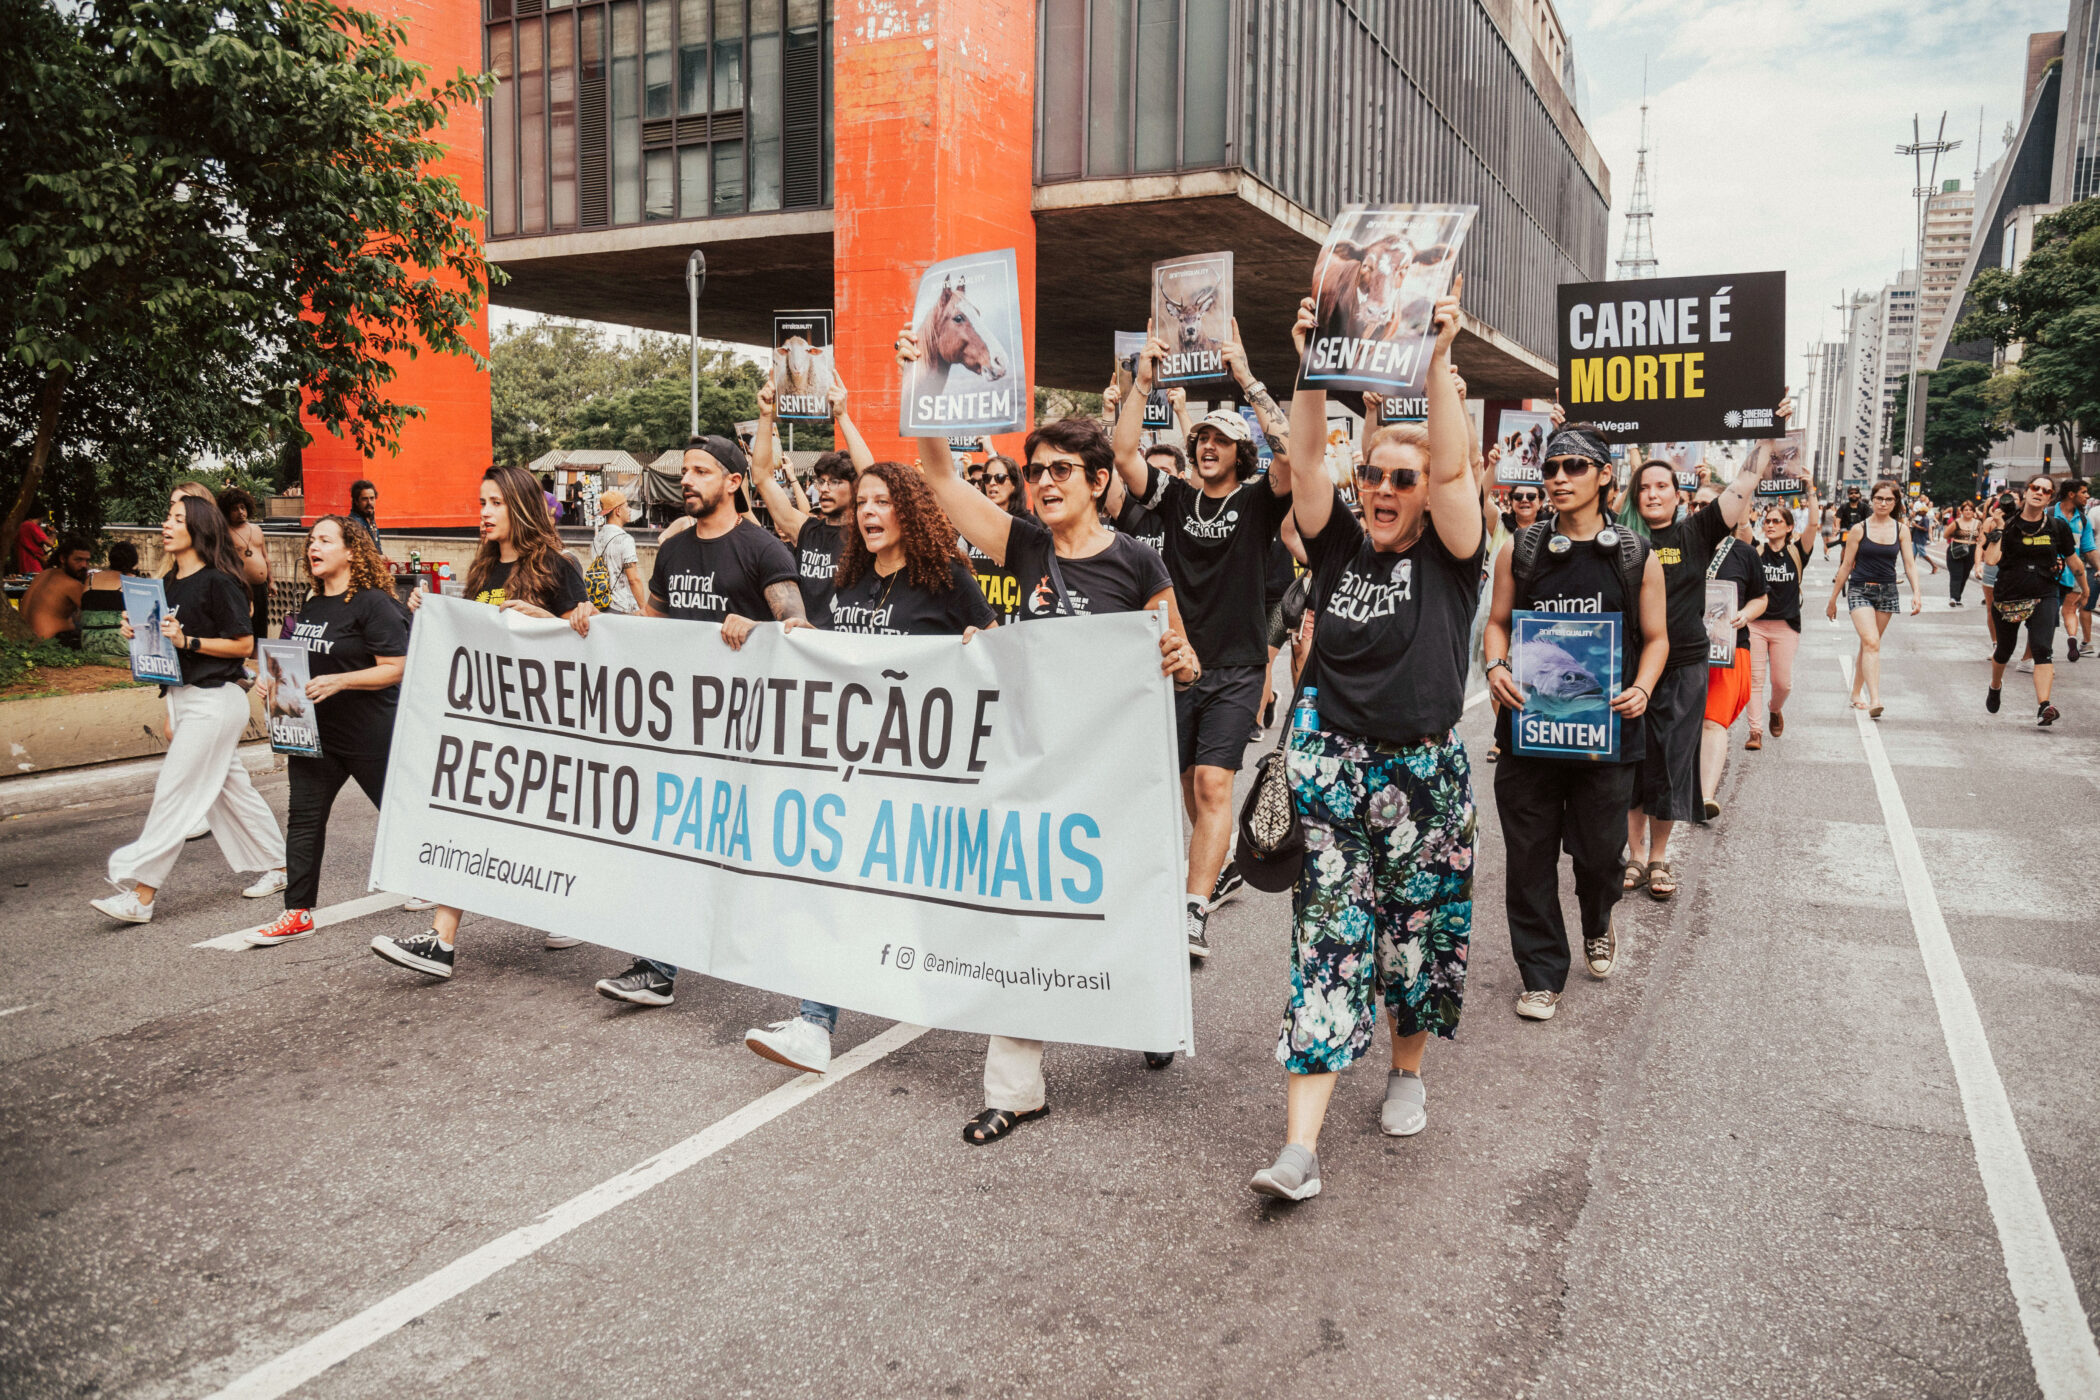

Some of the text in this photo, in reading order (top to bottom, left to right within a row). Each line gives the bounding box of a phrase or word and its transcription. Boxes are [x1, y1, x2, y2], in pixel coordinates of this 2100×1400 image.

[1570, 286, 1733, 350] CARNE É
[1162, 350, 1222, 375] SENTEM
[1313, 337, 1414, 376] SENTEM
[1571, 352, 1705, 404] MORTE
[780, 394, 826, 413] SENTEM
[918, 389, 1010, 420] SENTEM
[1386, 398, 1429, 415] SENTE
[1742, 409, 1773, 418] SINERGIA
[1742, 418, 1773, 428] ANIMAL
[1501, 467, 1542, 480] SENTEM
[1760, 478, 1800, 492] SENTEM
[800, 563, 838, 579] QUALIT
[1762, 562, 1787, 574] nimal
[1765, 572, 1795, 582] UALITY
[669, 569, 715, 593] animal
[669, 591, 729, 611] QUALITY
[1533, 591, 1602, 613] animal
[833, 602, 894, 626] animal
[293, 619, 329, 638] nimal
[138, 655, 176, 676] SENTEM
[447, 645, 1000, 783] QUEREMOS PROTEÇÃO E
[273, 725, 313, 746] SENTEM
[1525, 720, 1606, 747] SENTEM
[431, 734, 1104, 904] RESPEITO PARA OS ANIMAIS
[419, 839, 577, 898] animalEQUALITY
[923, 953, 1111, 992] @animalequaliybrasil
